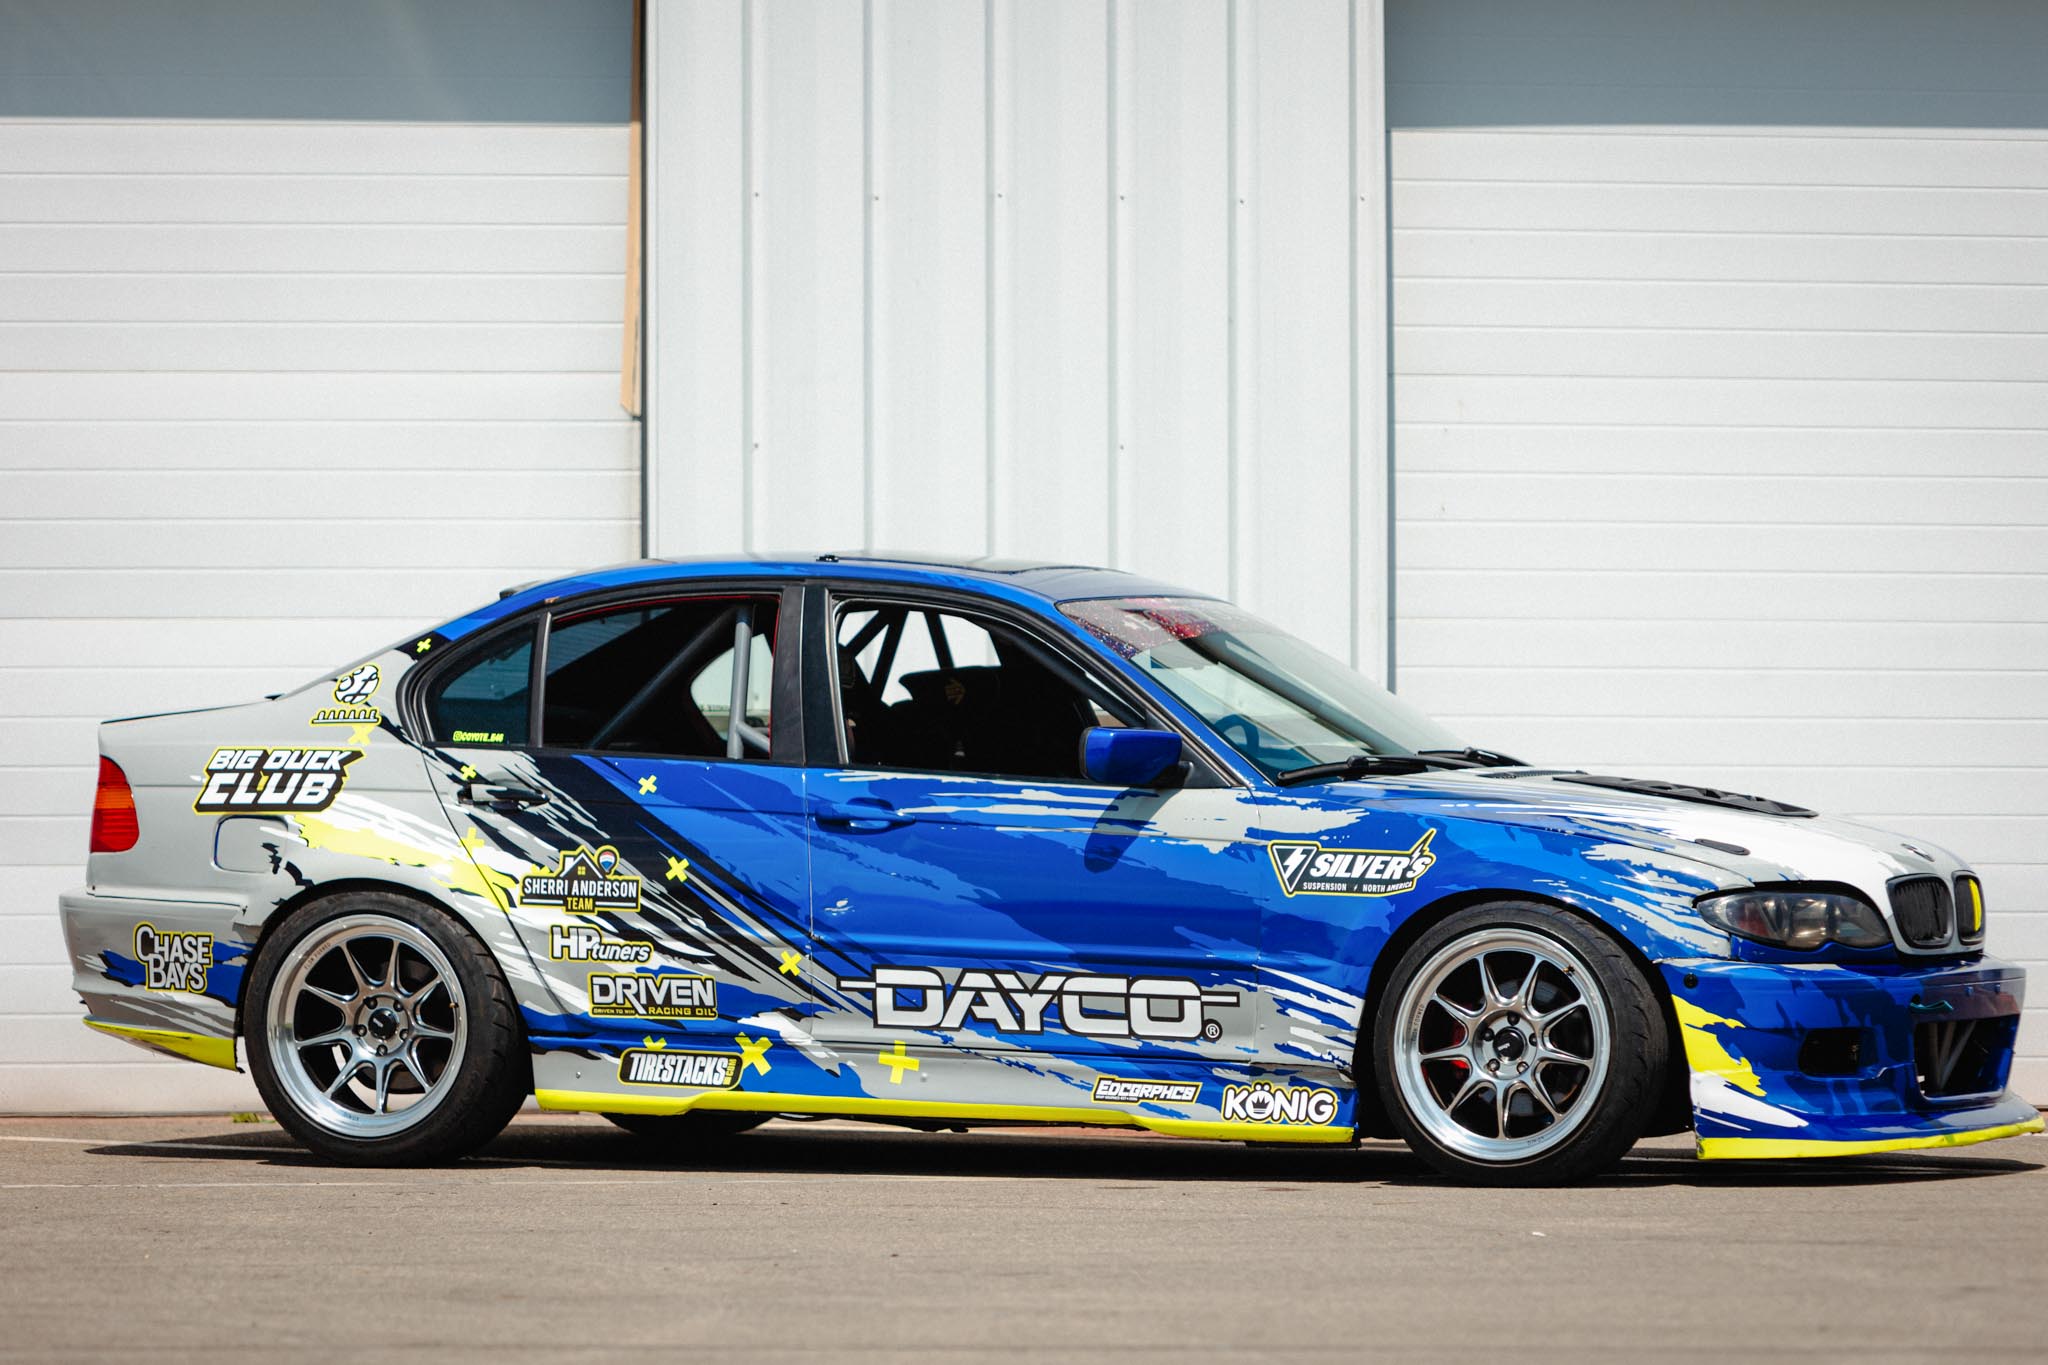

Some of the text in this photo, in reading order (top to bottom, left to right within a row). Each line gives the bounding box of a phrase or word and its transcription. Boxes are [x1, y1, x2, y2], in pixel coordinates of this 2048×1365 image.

[208, 750, 352, 771] BIG DUCK
[199, 772, 337, 804] CLUB
[524, 878, 637, 898] SHERRI ANDERSON
[1303, 881, 1413, 893] SUSPENSION NORTH AMERICA
[567, 898, 594, 911] TEAM
[136, 926, 210, 964] CHASE
[149, 953, 204, 990] BAYS
[592, 976, 715, 1015] DRIVEN
[648, 1006, 715, 1016] RACING OIL
[874, 967, 1202, 1040] DAYCO
[629, 1052, 728, 1086] TIRESTACKS
[1224, 1084, 1335, 1123] KÖNIG
